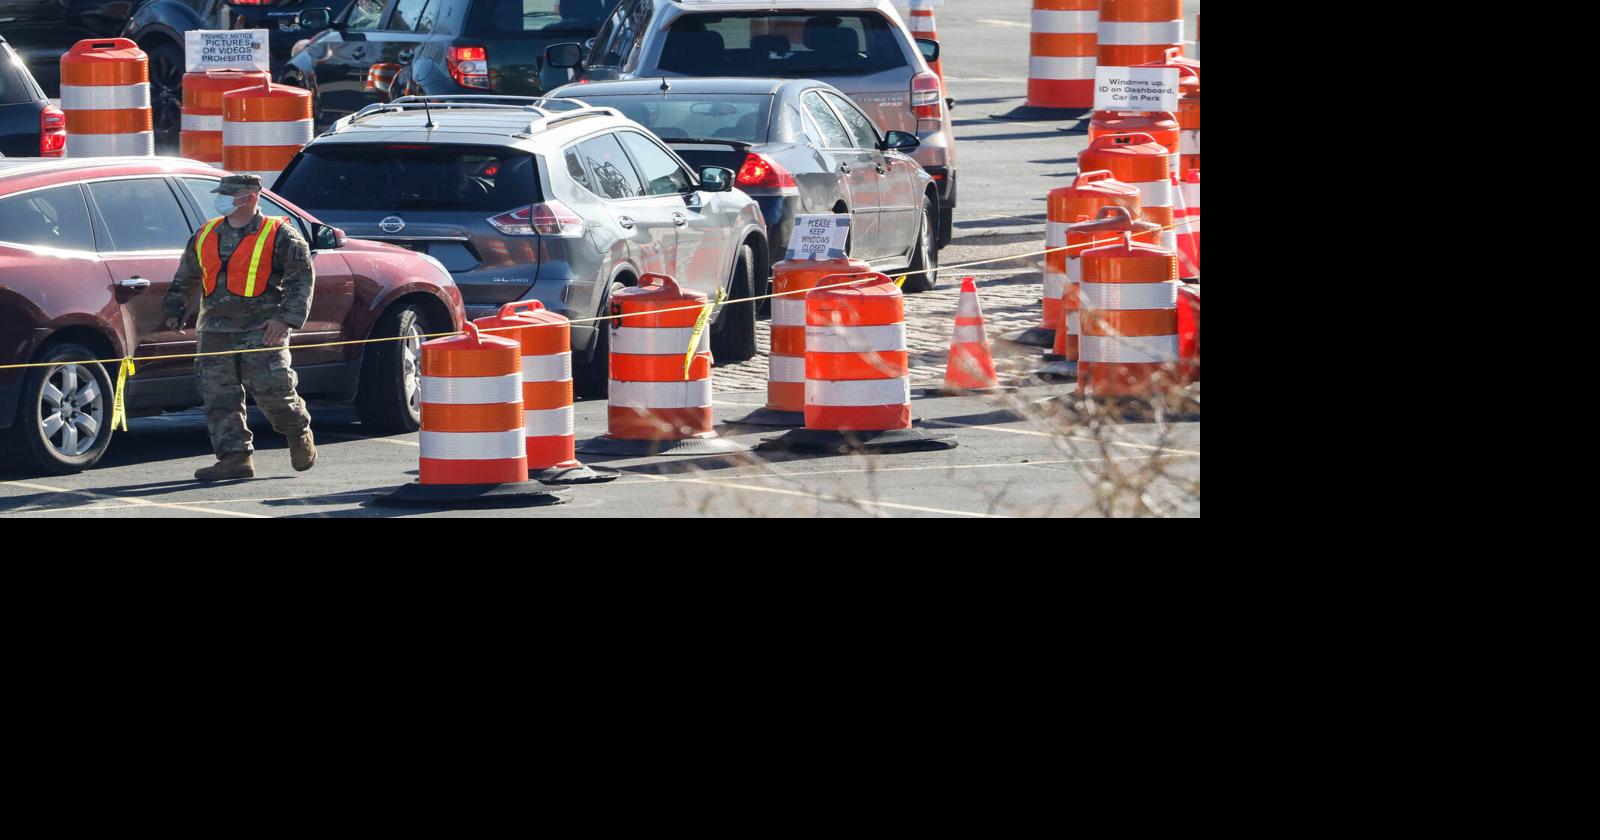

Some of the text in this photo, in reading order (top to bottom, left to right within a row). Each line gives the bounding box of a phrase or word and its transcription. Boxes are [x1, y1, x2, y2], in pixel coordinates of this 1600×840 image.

[219, 46, 252, 54] VIDEOS
[201, 54, 253, 62] PROHIBITED
[808, 219, 831, 228] PLEASE
[809, 228, 826, 236] KEEP
[801, 235, 830, 244] WINDOWS
